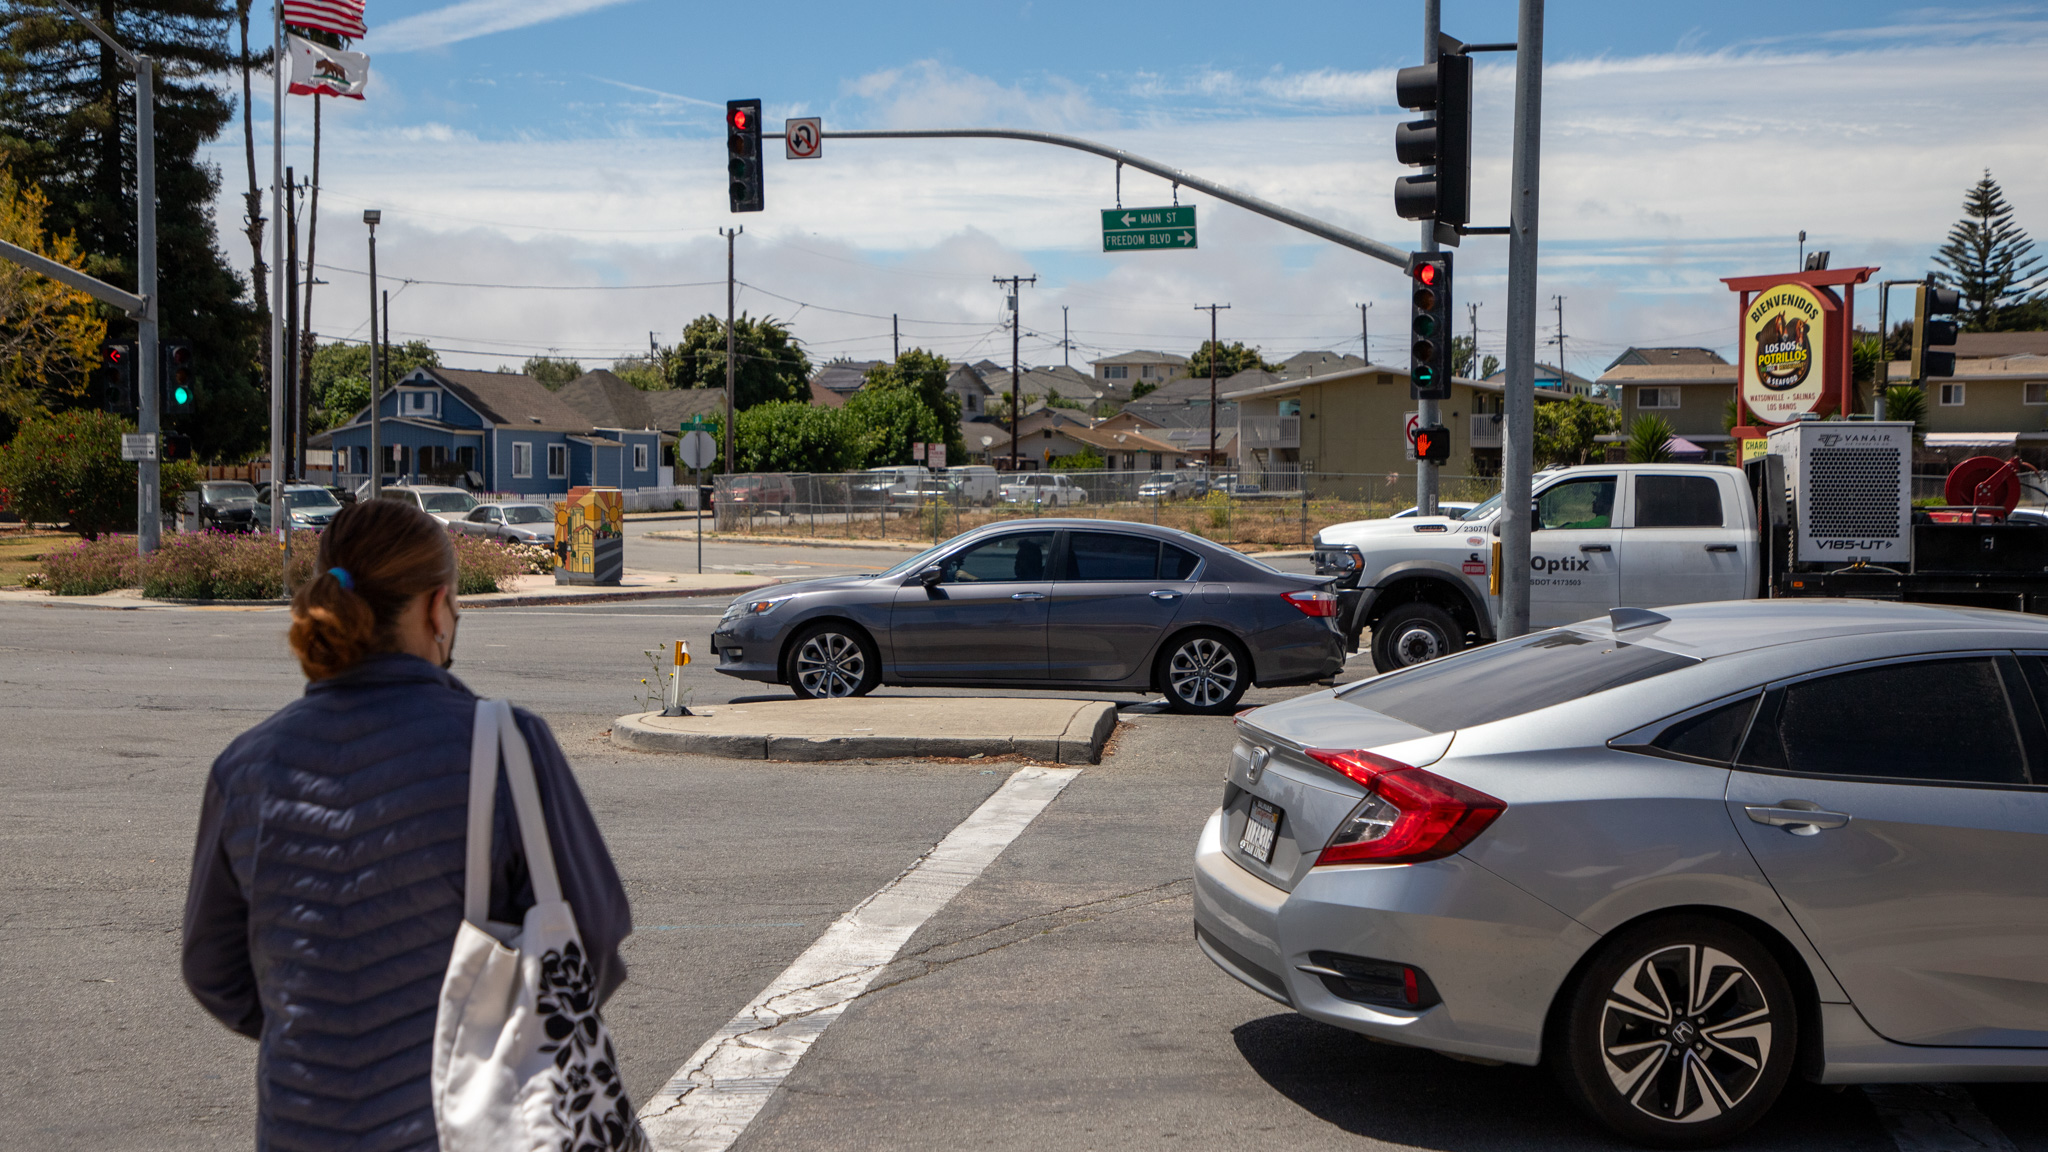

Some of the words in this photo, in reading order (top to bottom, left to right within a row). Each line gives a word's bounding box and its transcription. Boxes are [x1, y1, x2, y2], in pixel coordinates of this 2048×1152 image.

[1141, 213, 1161, 224] MAIN
[1166, 212, 1176, 223] ST
[1106, 234, 1145, 246] FREEDOM
[1149, 233, 1171, 244] BLVD
[1751, 293, 1819, 323] BIENVENIDOS
[1765, 342, 1779, 354] LOS
[1780, 340, 1796, 353] DOS
[1758, 348, 1807, 366] POTRILLOS
[1771, 374, 1798, 386] SEAFOOD
[1750, 394, 1784, 402] WATSONVILLE
[1792, 392, 1816, 400] SALINAS
[1767, 403, 1777, 411] LOS
[1845, 434, 1890, 442] VANAIR
[1463, 525, 1487, 533] 23071
[1816, 540, 1885, 550] V185-UT
[1530, 555, 1590, 575] Optix
